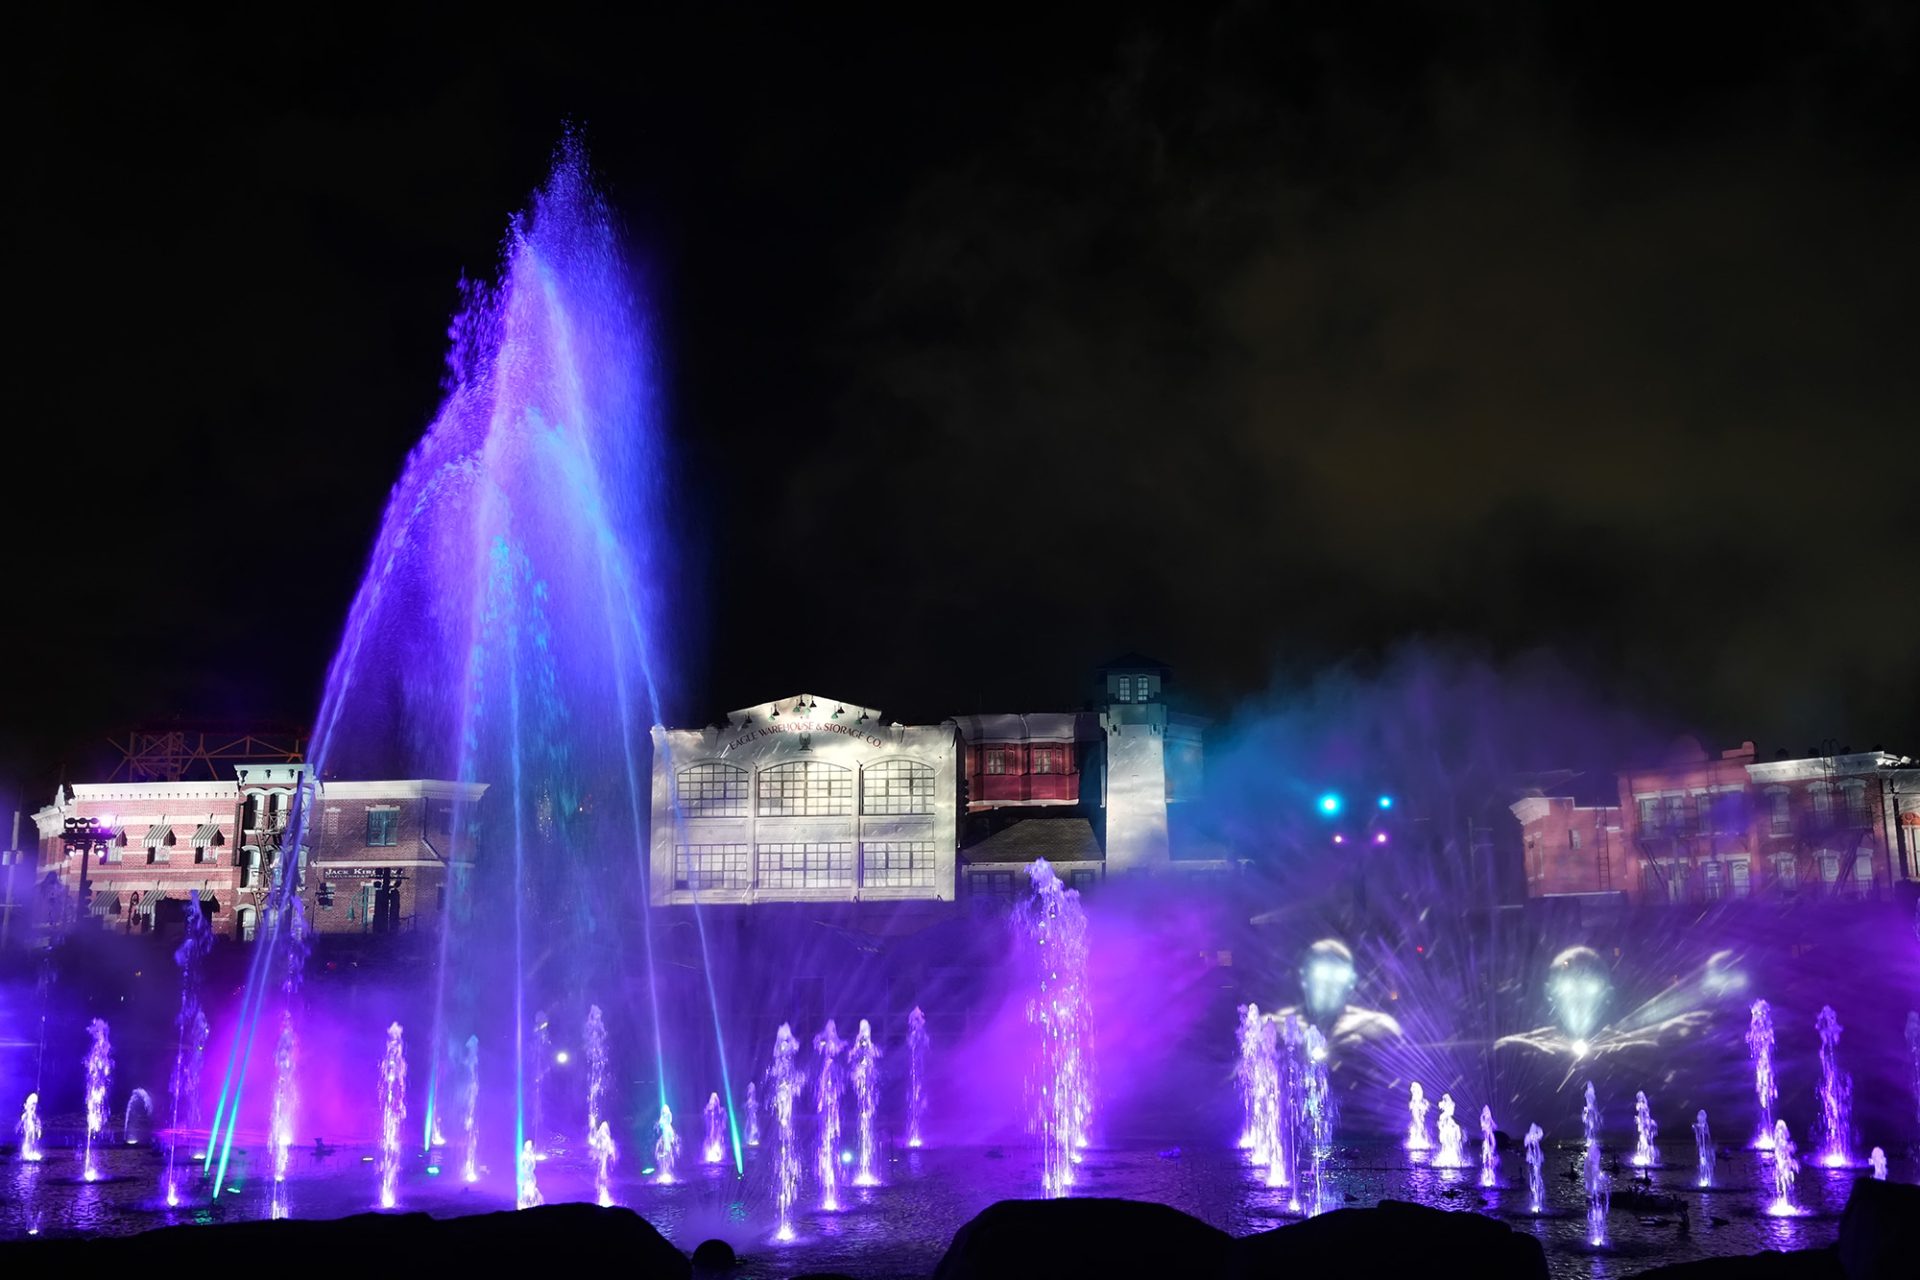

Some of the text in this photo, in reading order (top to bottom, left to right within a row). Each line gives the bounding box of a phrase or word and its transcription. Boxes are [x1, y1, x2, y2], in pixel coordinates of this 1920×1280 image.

[729, 731, 759, 750] EAGLE
[758, 721, 815, 737] WAREHOUSE
[823, 723, 865, 740] STORAGE
[866, 735, 882, 749] CO.
